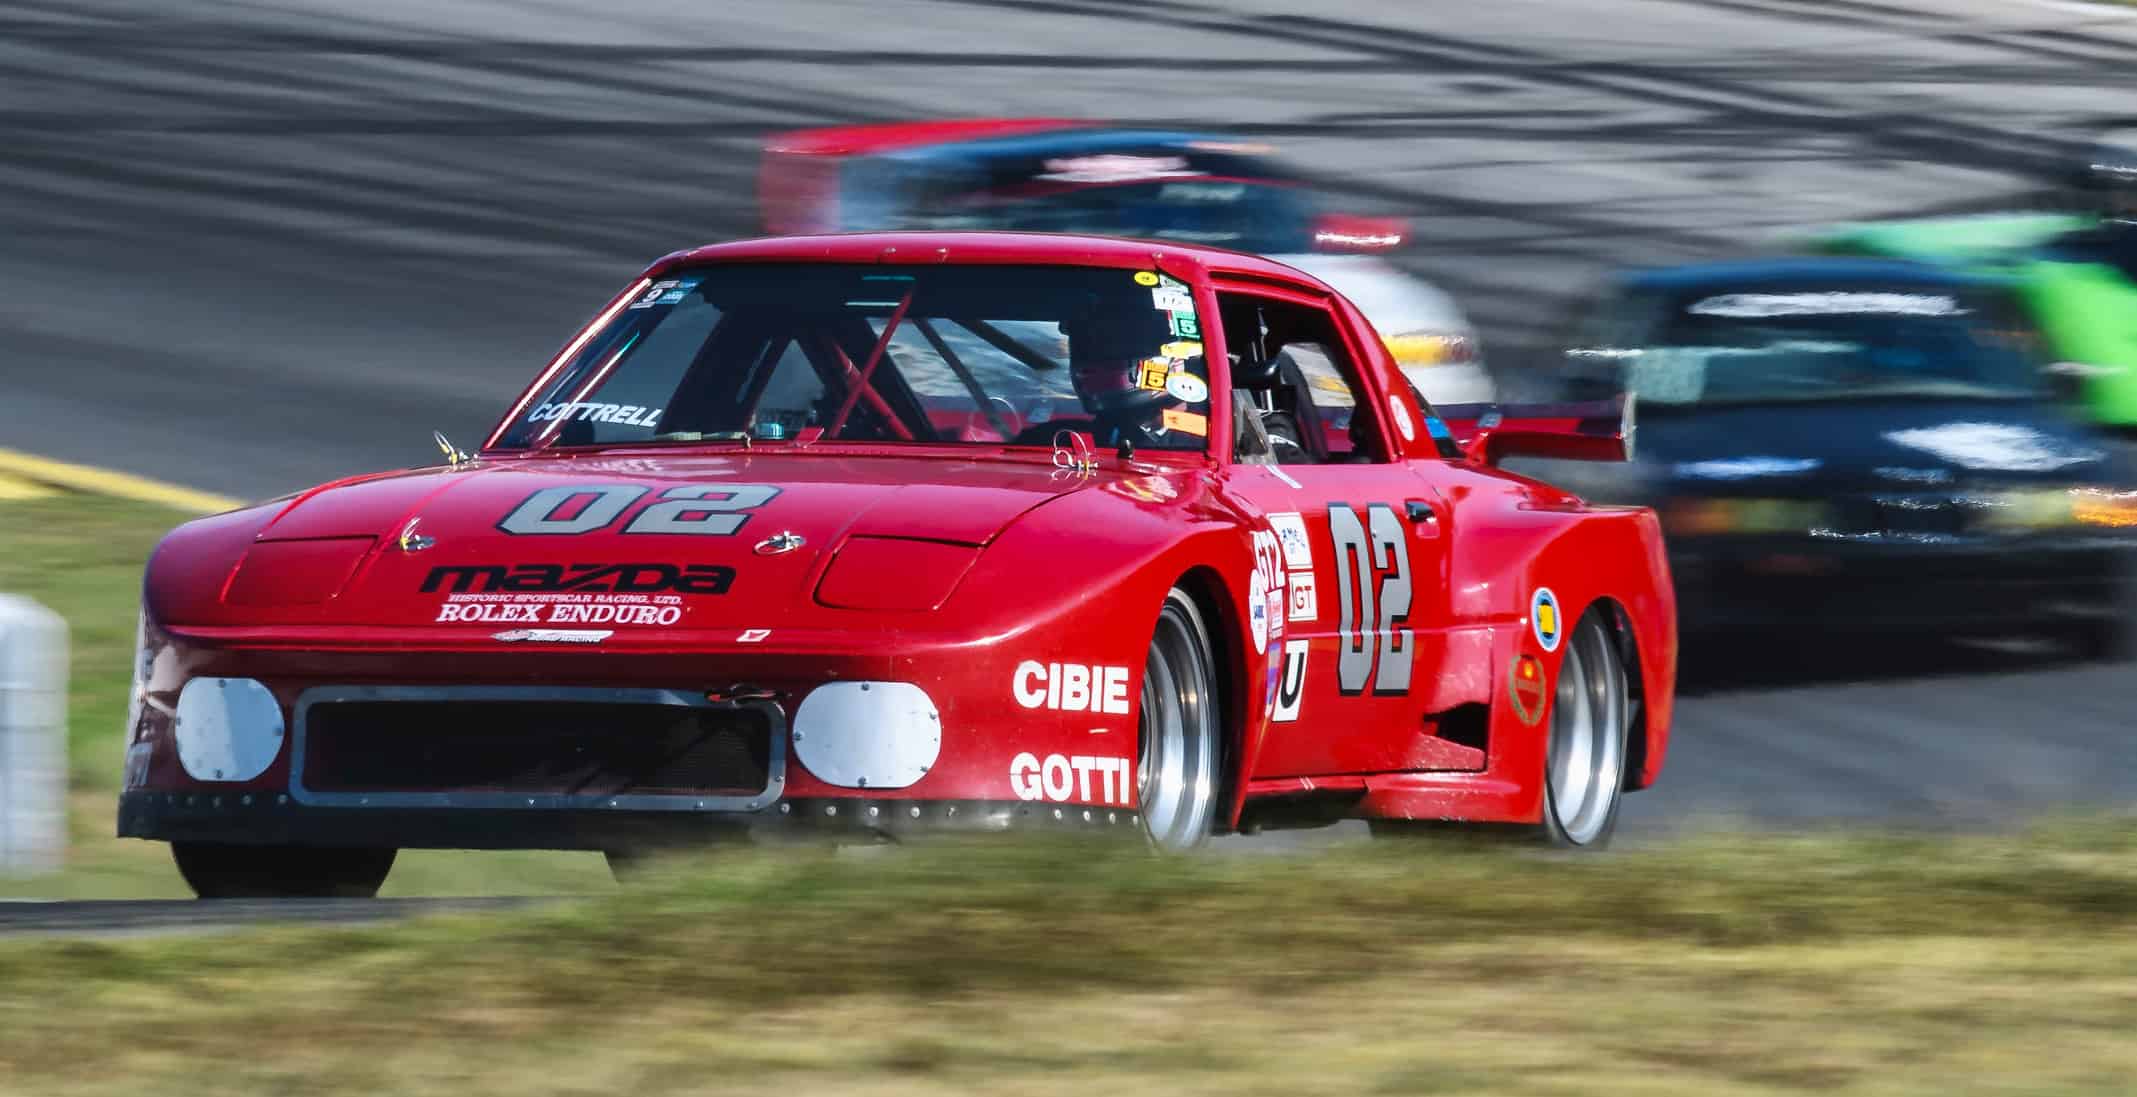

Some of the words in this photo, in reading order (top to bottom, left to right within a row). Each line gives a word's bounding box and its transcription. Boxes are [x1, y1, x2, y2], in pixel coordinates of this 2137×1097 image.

[528, 402, 662, 427] COTTRELL
[494, 484, 784, 536] 02
[435, 604, 543, 623] ROLEX
[547, 605, 682, 626] ENDURO
[448, 593, 513, 603] HISTORIC
[514, 593, 592, 603] SPORTSCAR
[1328, 502, 1415, 696] 02
[1013, 659, 1129, 714] CIBIE
[1010, 752, 1130, 804] GOTTI
